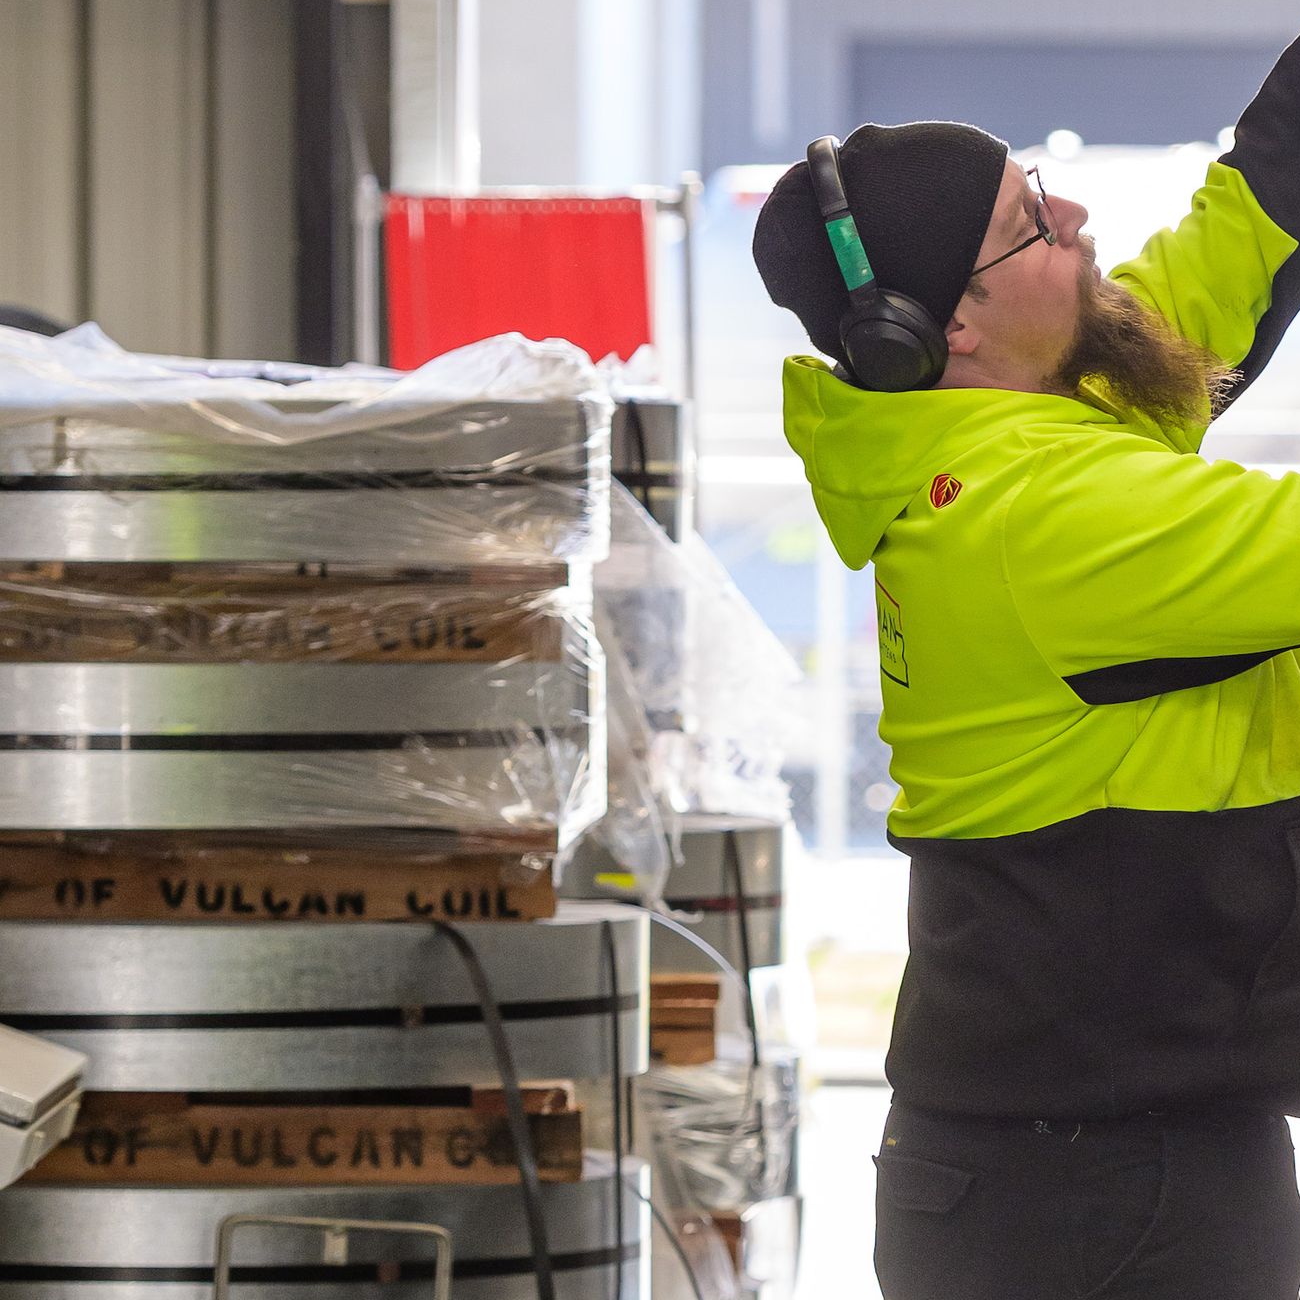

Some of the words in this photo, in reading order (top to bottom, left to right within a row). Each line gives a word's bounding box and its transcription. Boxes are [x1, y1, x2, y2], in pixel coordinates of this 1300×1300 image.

[55, 878, 116, 908] OF
[159, 878, 366, 917] VULCAN
[406, 886, 521, 918] COIL
[189, 1125, 424, 1168] VULCAN
